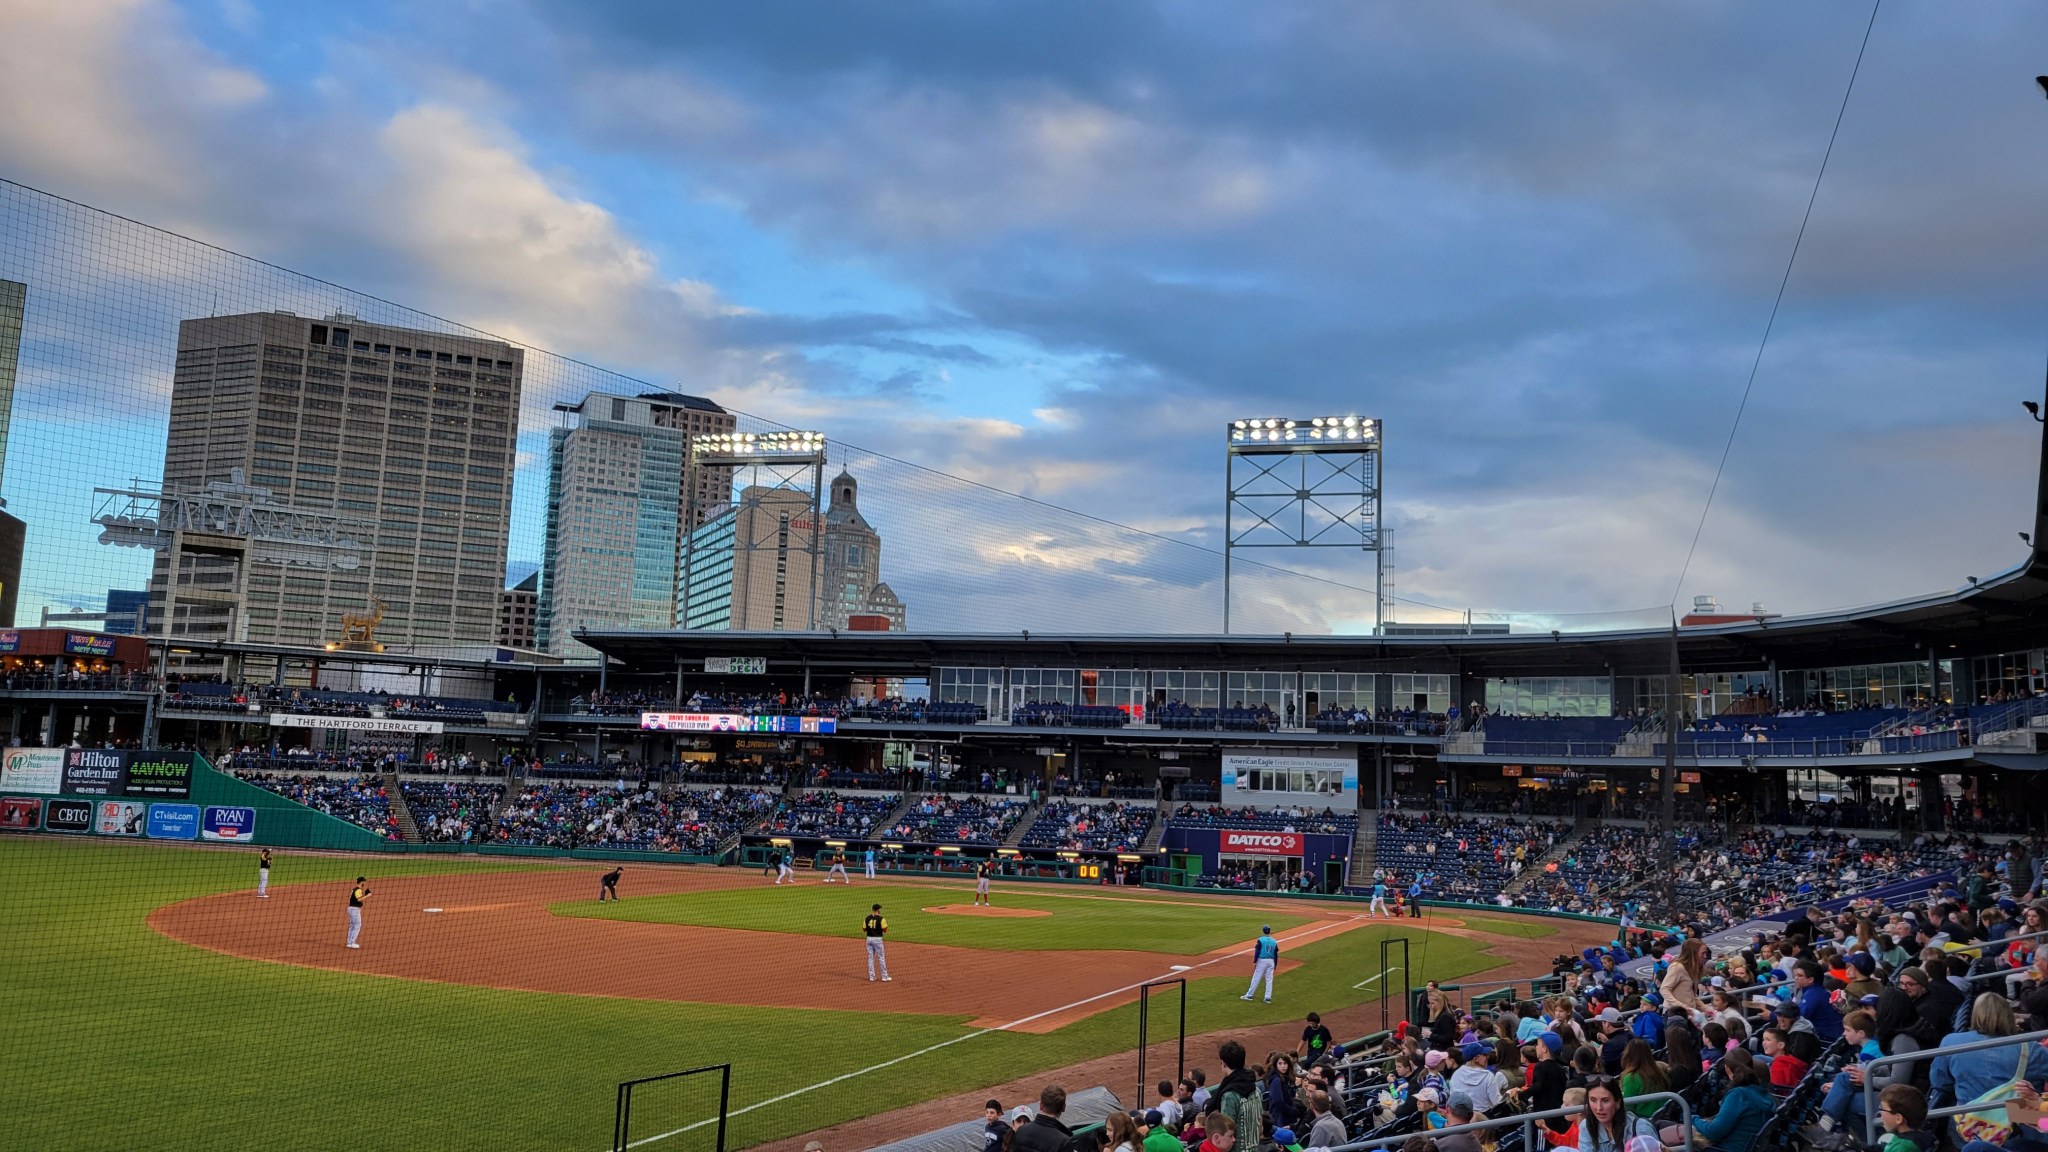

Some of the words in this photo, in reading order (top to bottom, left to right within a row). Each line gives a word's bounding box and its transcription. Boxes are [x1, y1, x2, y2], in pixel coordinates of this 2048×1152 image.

[297, 718, 316, 726] THE
[320, 720, 374, 729] HARTFORD
[376, 722, 420, 732] TERRACE
[80, 752, 120, 768] Hilton
[1258, 758, 1274, 766] Eagle
[68, 766, 101, 778] Garden
[102, 769, 118, 779] Inn
[130, 760, 190, 776] 4AVNOW
[58, 808, 88, 822] CBTG
[215, 808, 246, 823] RYAN
[1228, 834, 1282, 846] DATTCO
